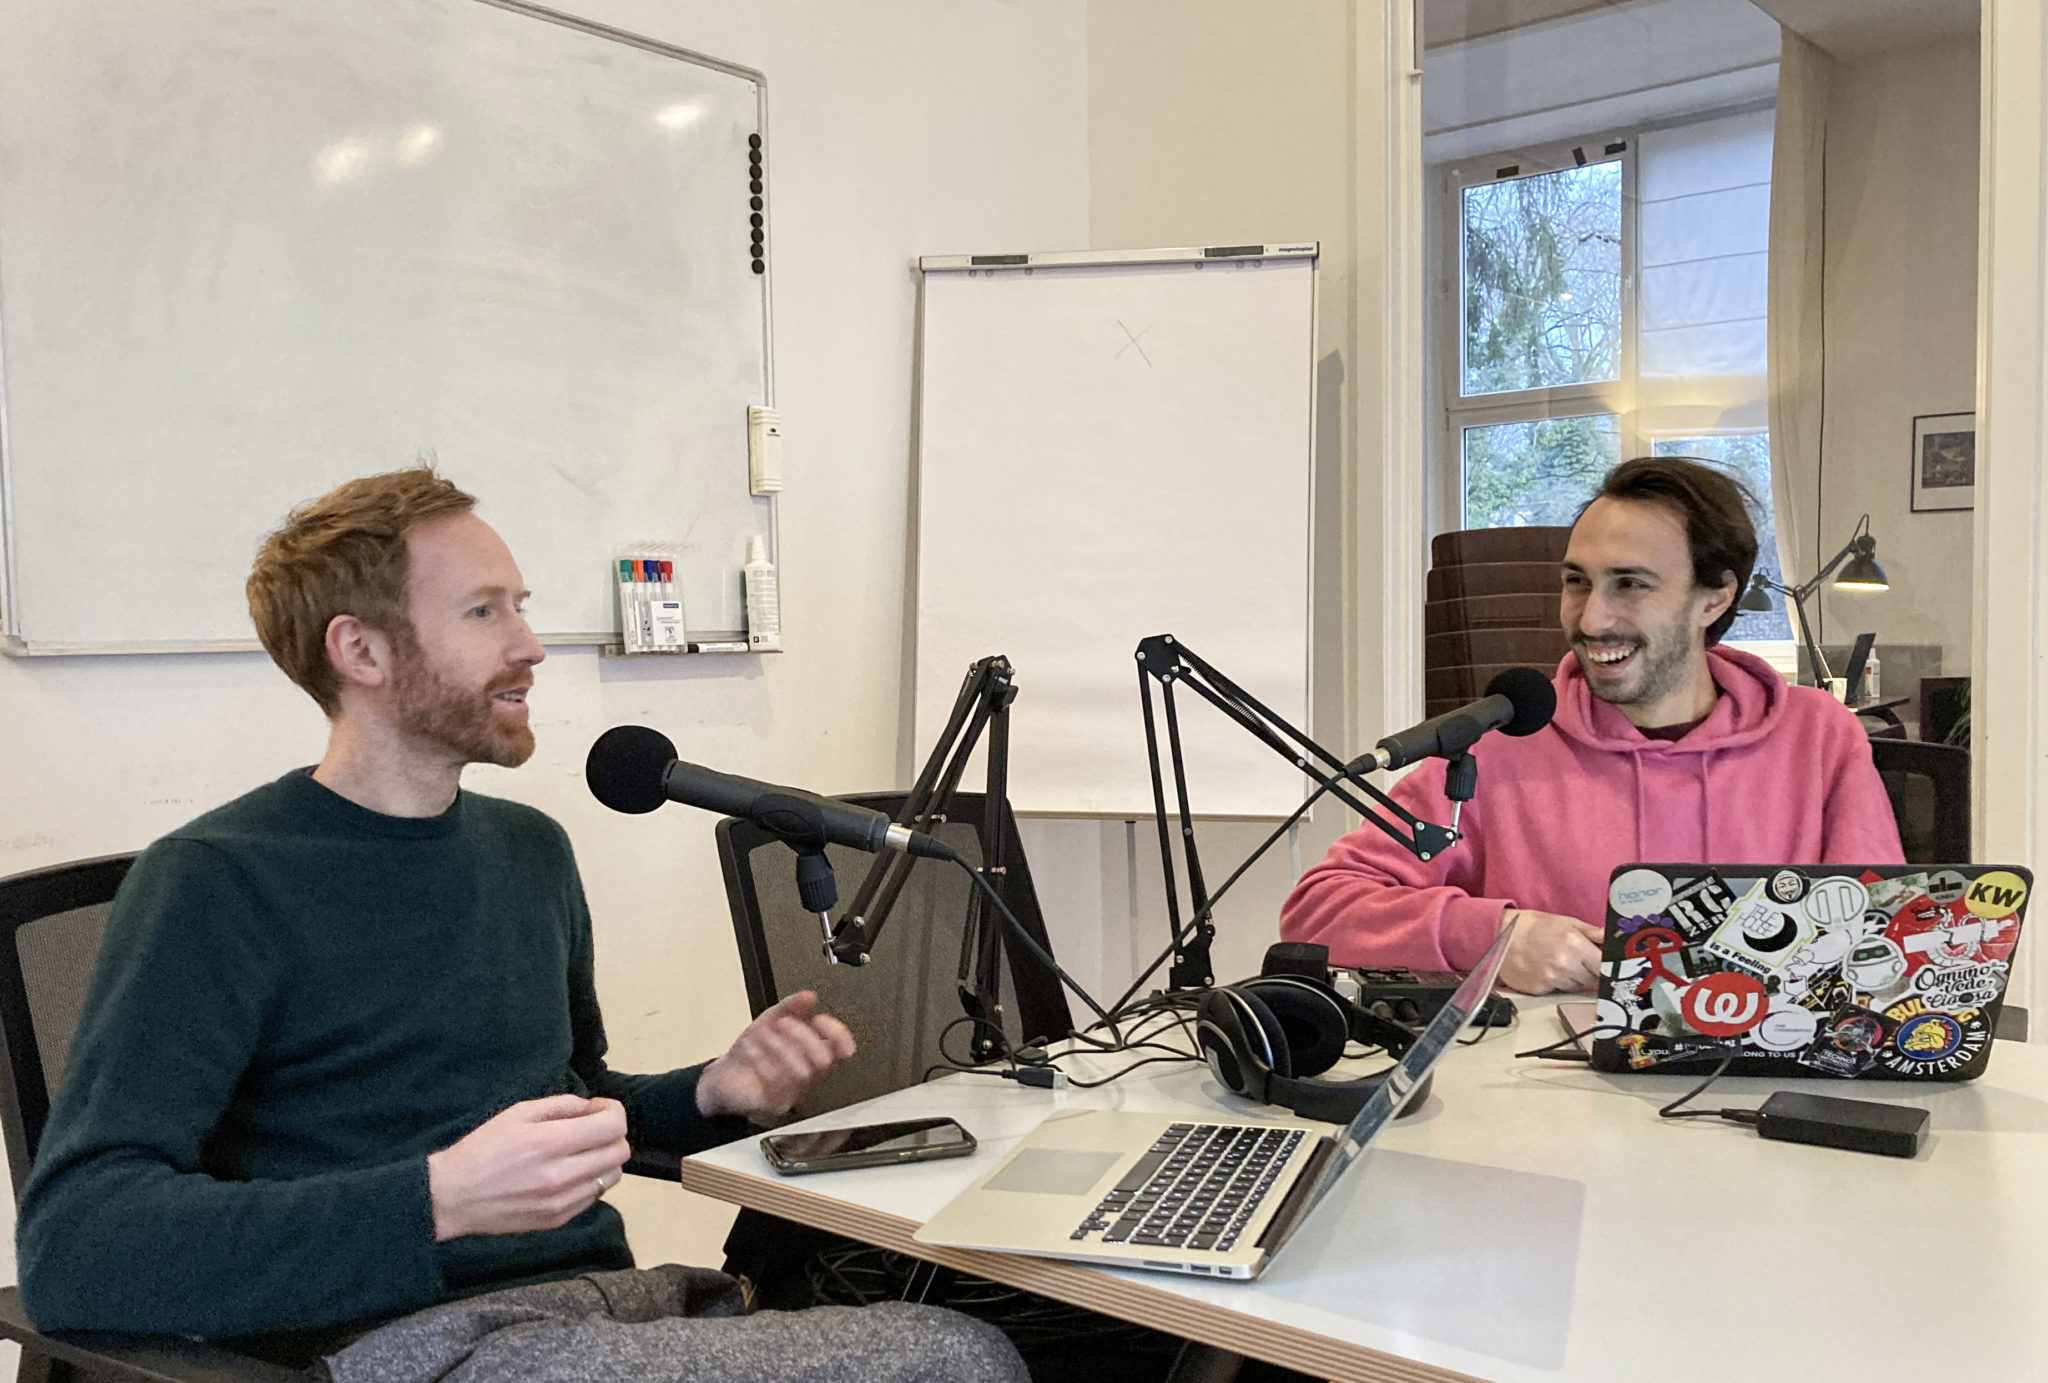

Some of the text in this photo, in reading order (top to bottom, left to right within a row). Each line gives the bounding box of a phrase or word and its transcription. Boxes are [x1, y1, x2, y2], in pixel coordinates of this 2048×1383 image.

[1618, 887, 1662, 900] honor
[1969, 882, 2023, 908] KW
[1722, 947, 1730, 955] a
[1732, 952, 1772, 975] Feeling
[1884, 1030, 1987, 1075] AMSTERDAM
